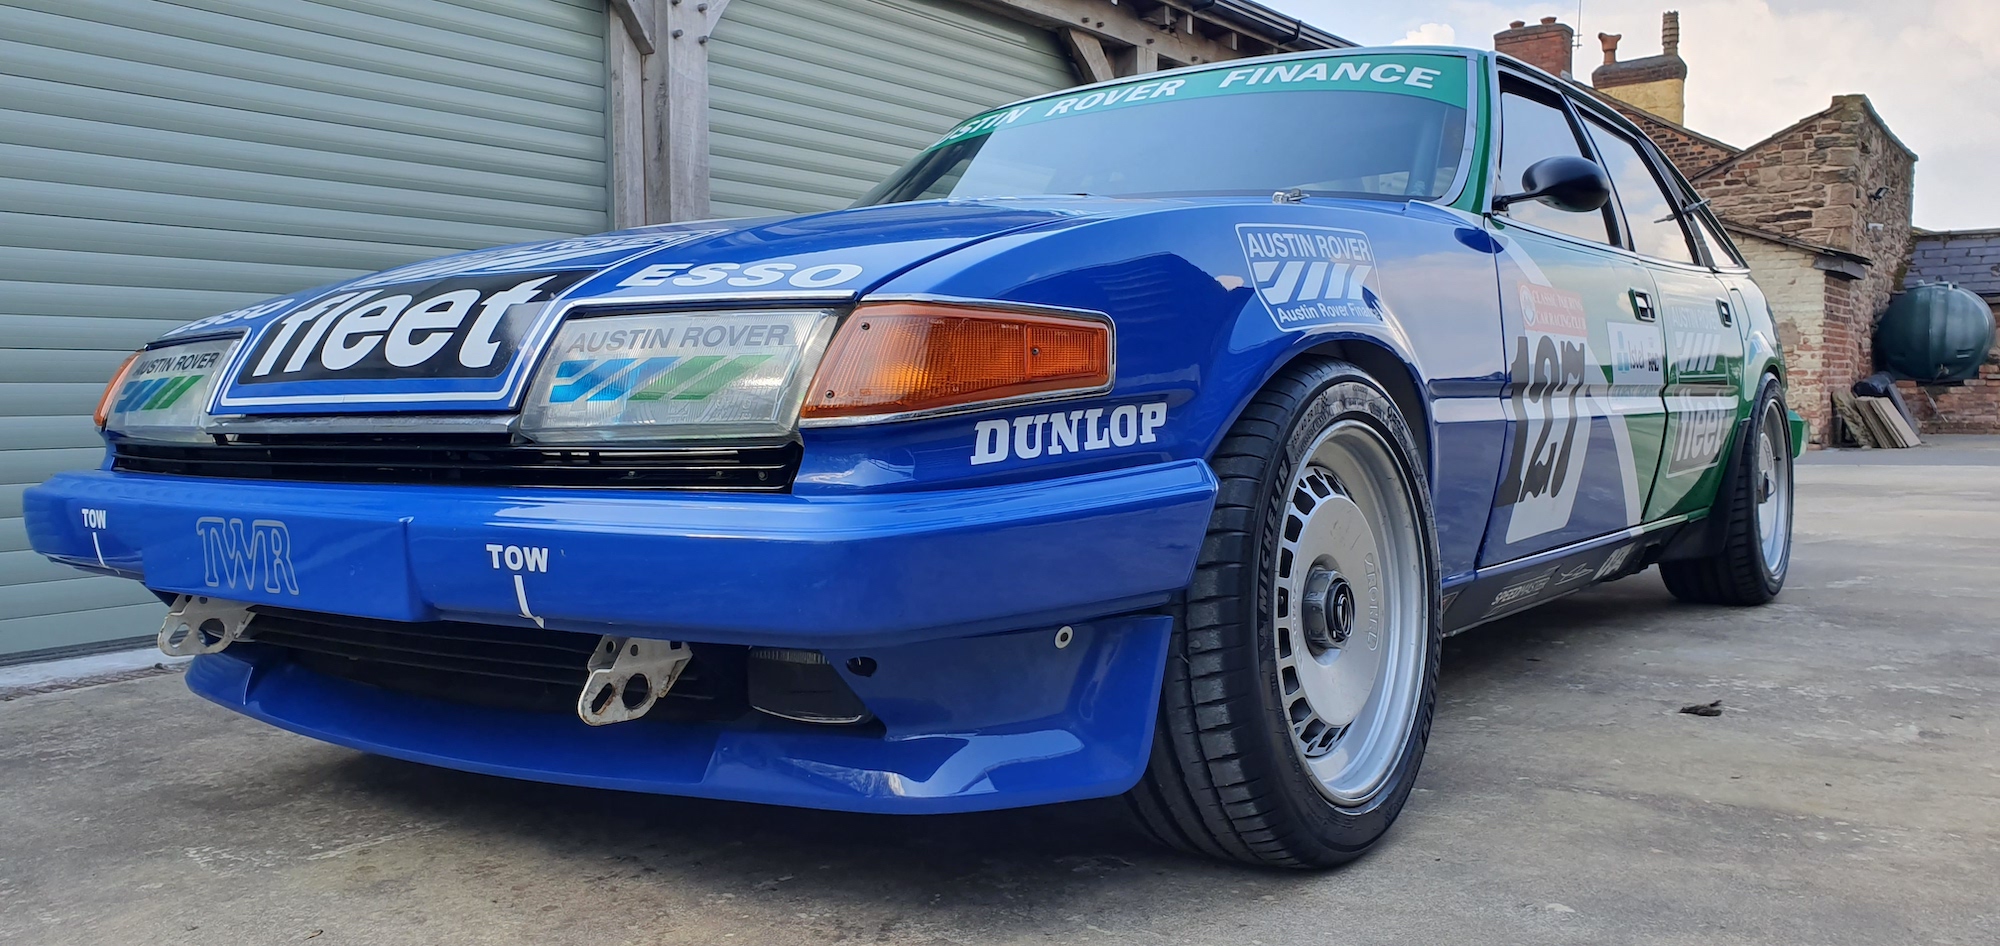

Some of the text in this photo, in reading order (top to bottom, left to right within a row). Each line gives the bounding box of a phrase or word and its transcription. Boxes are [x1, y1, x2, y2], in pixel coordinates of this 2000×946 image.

[930, 61, 1442, 149] USTIN ROVER FINANCE
[1247, 232, 1372, 262] AUSTIN ROVER
[616, 263, 863, 288] ESSO
[252, 274, 558, 377] fleet
[1277, 305, 1318, 323] Austin
[1319, 303, 1348, 318] Rover
[567, 324, 790, 353] AUSTIN ROVER
[133, 352, 220, 376] AUSTIN ROVER
[970, 402, 1168, 465] DUNLOP
[1494, 335, 1585, 507] 127
[1675, 385, 1728, 462] fleet
[82, 508, 106, 530] TOW
[1259, 460, 1290, 614] MICHELIN
[196, 516, 299, 596] TWR
[486, 543, 549, 573] TOW
